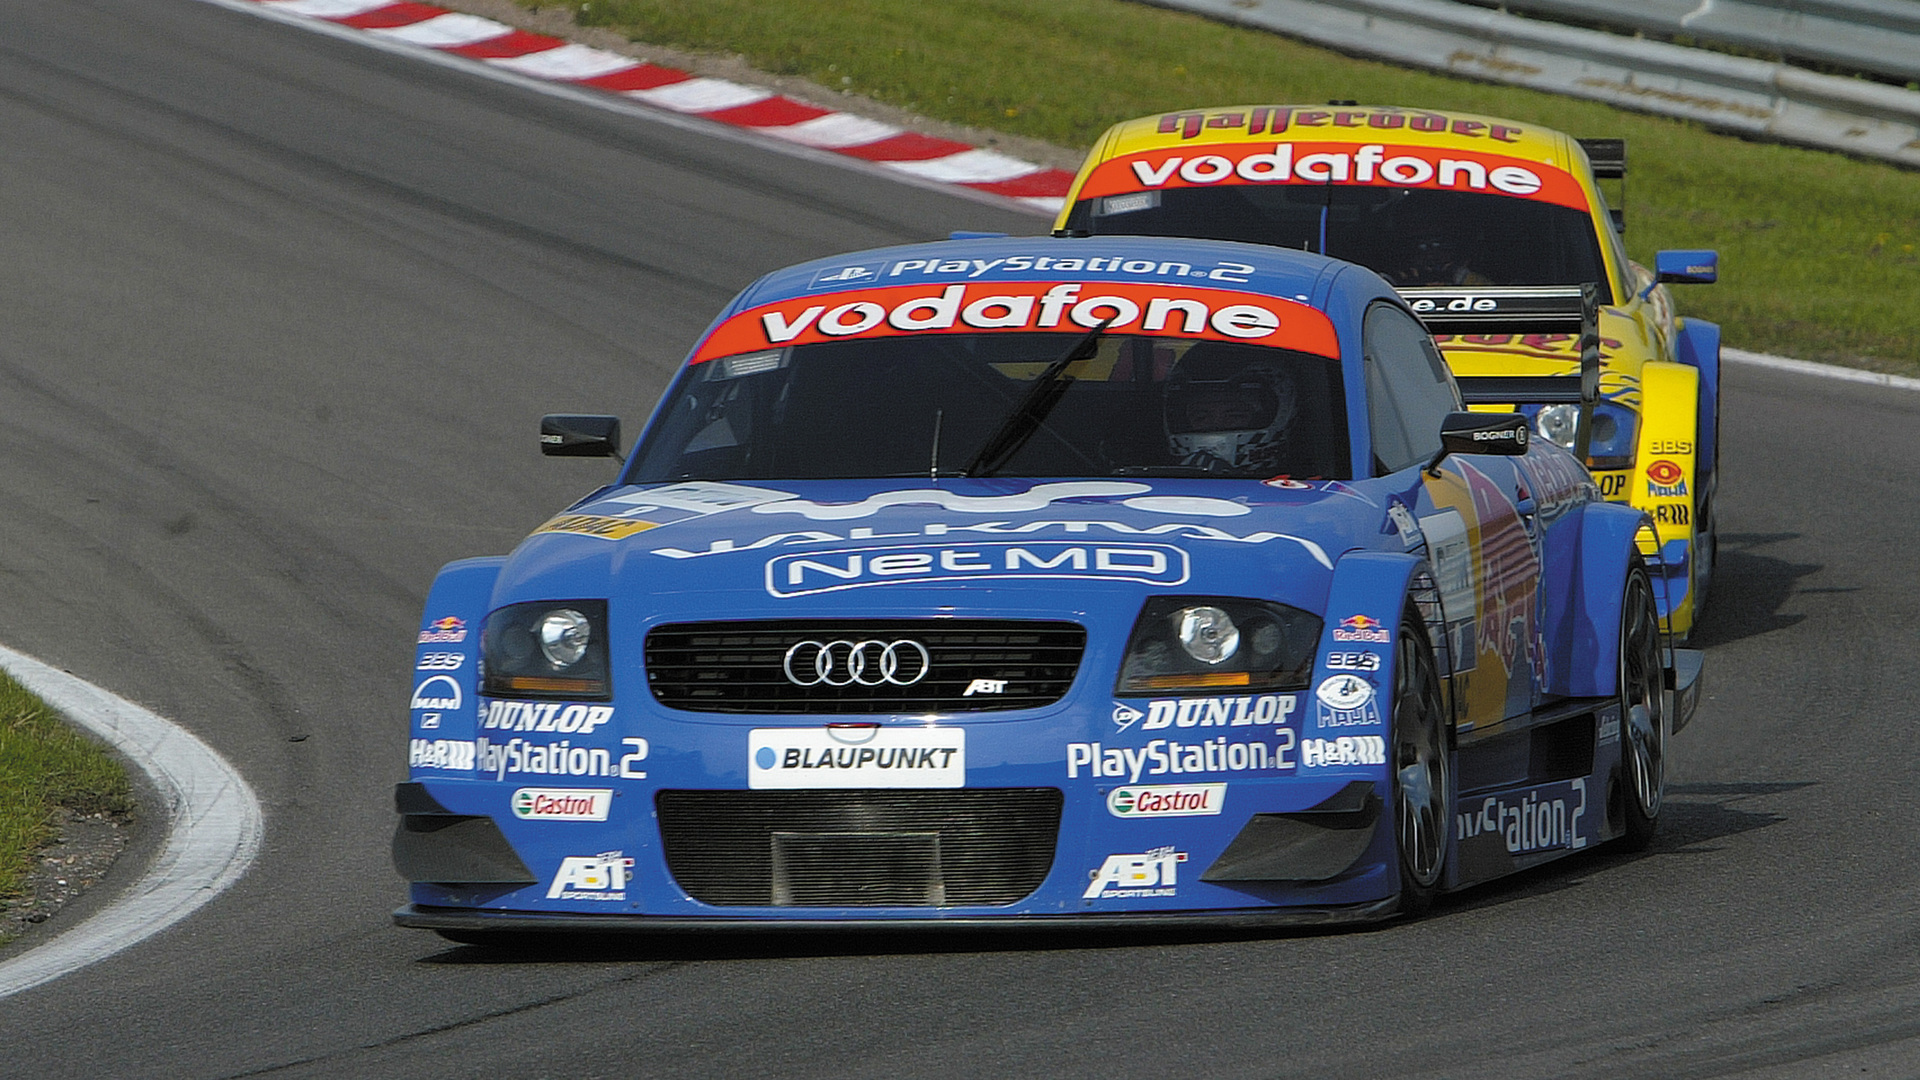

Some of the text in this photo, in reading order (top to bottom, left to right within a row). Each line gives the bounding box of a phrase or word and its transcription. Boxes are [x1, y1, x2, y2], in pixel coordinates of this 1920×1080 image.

[1132, 143, 1542, 195] vodafone
[890, 256, 1256, 282] PlayStation 2
[762, 283, 1280, 343] vodafone
[1473, 430, 1515, 441] BOGNER
[1649, 440, 1692, 455] BBS
[963, 679, 1008, 696] ABT
[485, 701, 615, 734] DUNLOP
[1142, 696, 1296, 730] DUNLOP
[620, 737, 648, 779] 2
[781, 747, 957, 769] BLAUPUNKT
[1067, 728, 1296, 783] PlayStation 2
[534, 794, 594, 816] Castrol
[1137, 789, 1209, 812] Castrol
[546, 856, 635, 899] ABT
[1082, 853, 1189, 898] ABT
